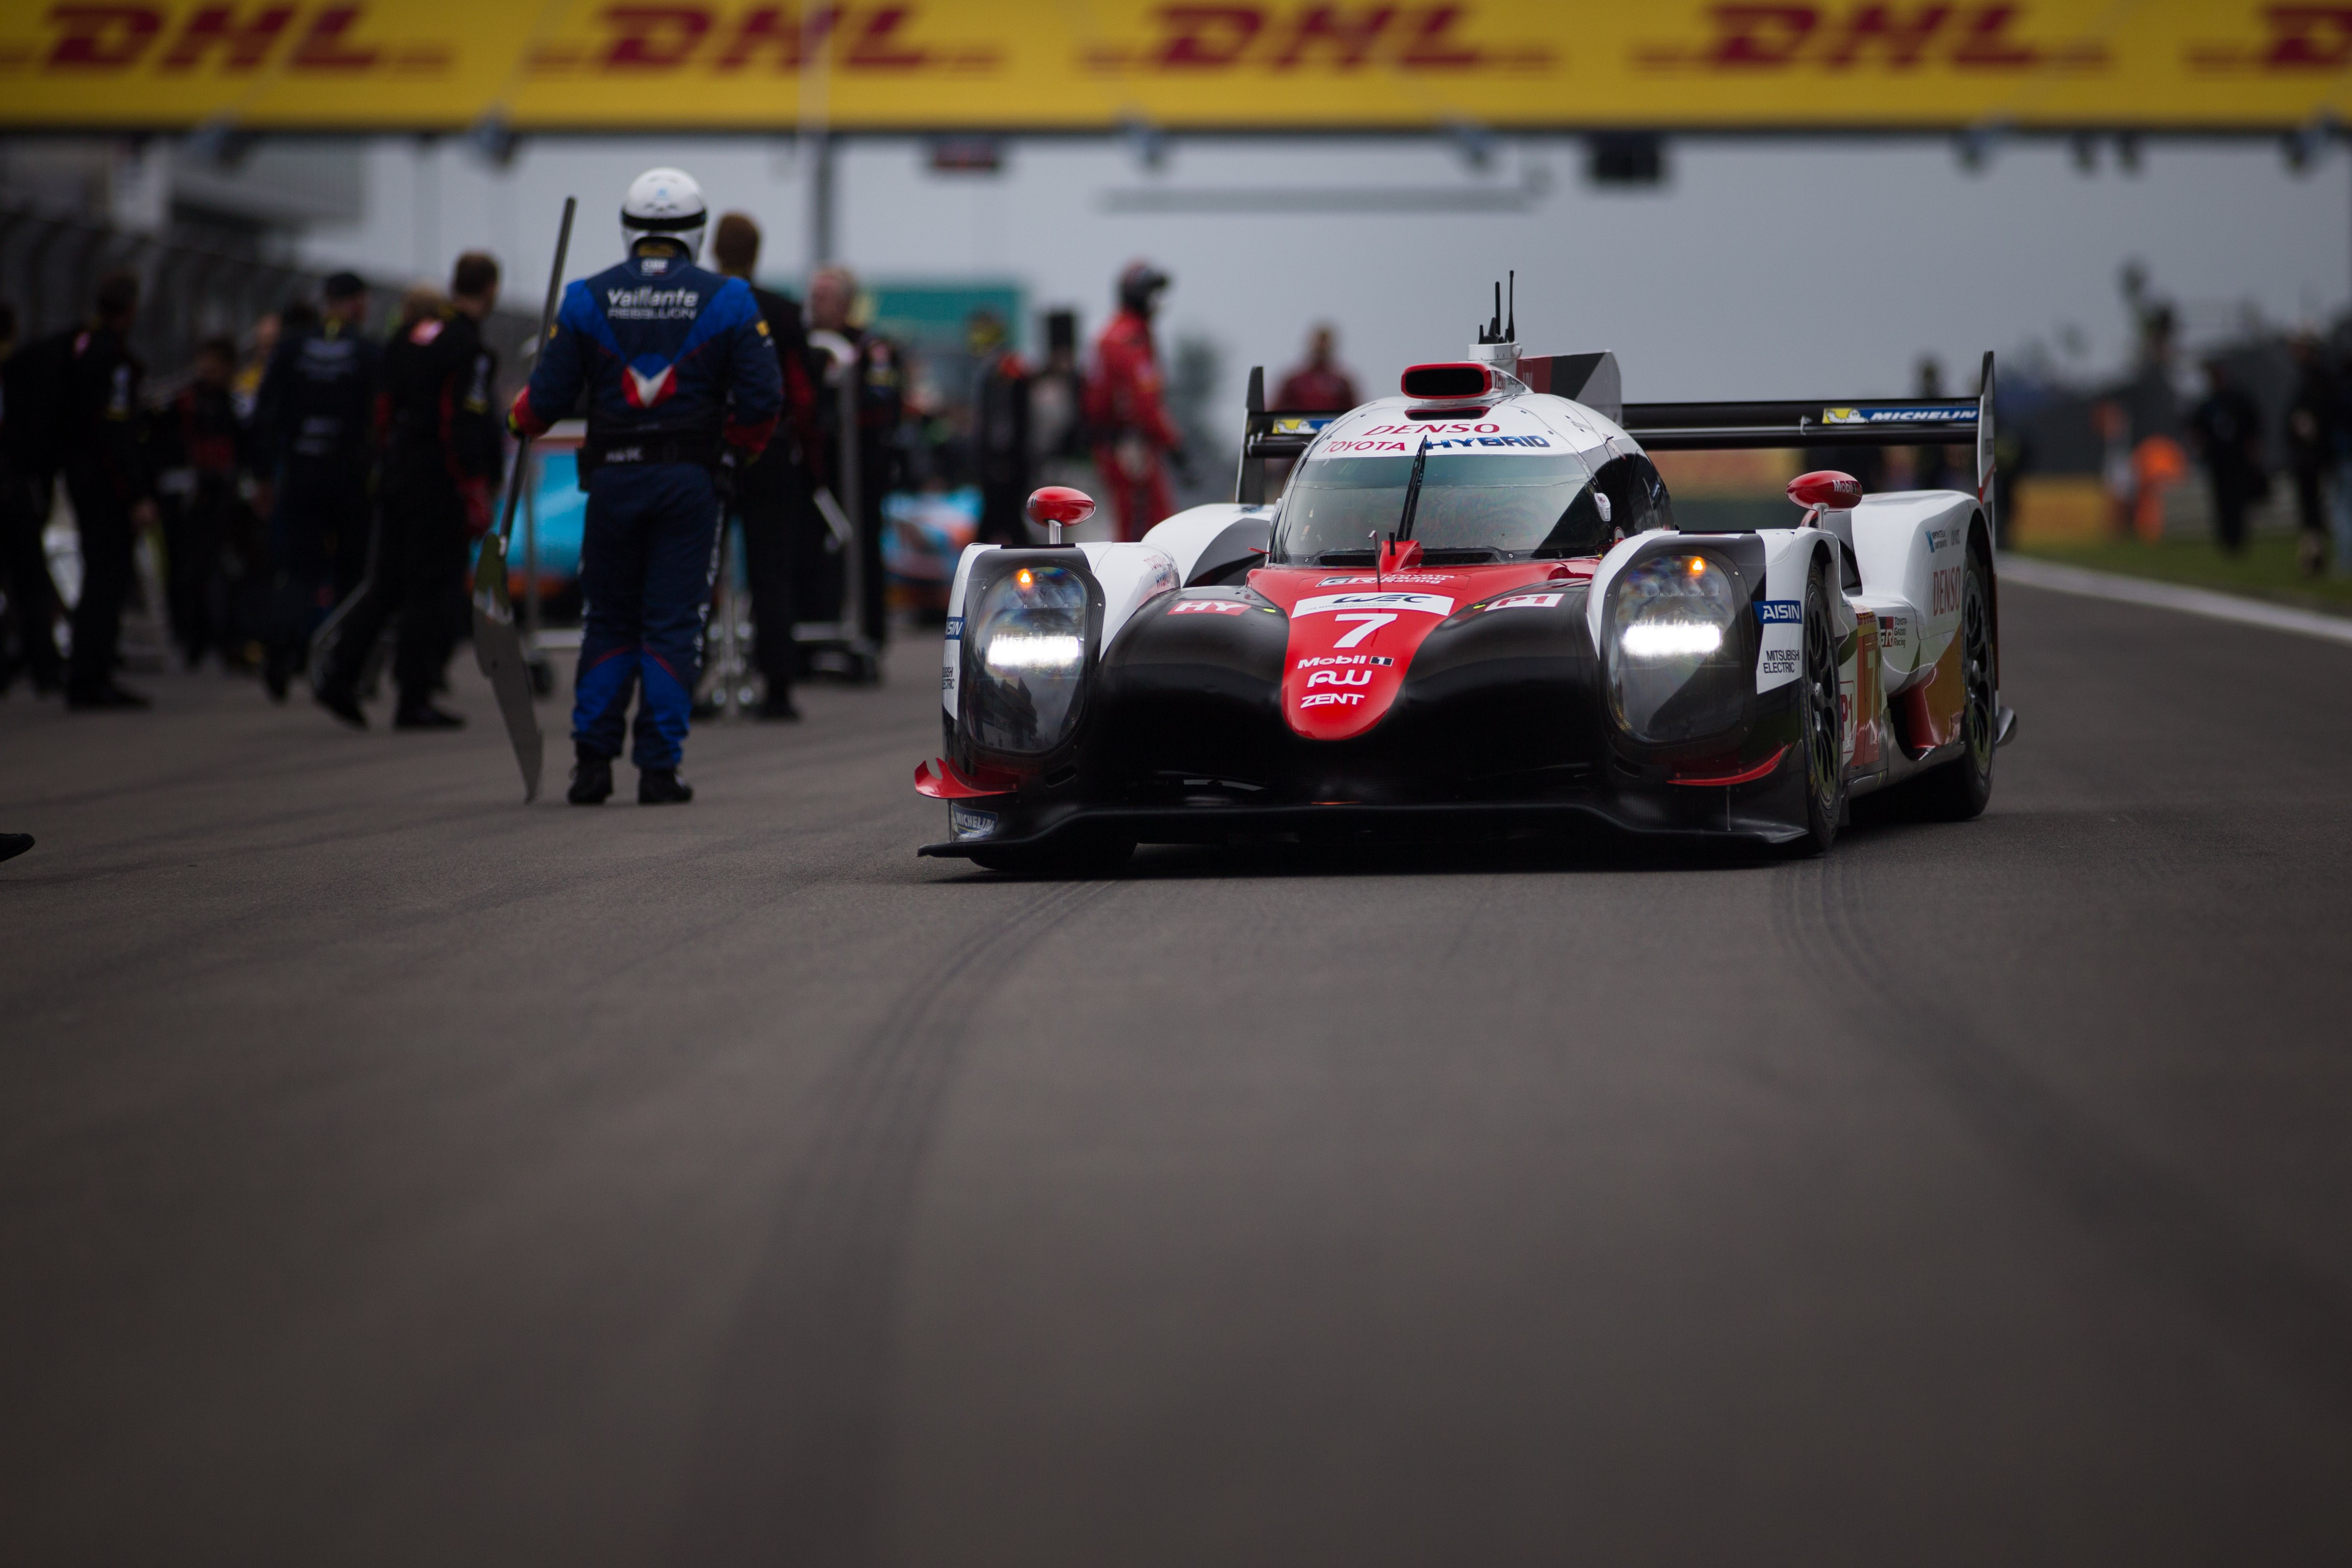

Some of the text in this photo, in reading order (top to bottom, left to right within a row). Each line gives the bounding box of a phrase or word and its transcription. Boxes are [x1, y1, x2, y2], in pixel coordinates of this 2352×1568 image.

[48, 4, 379, 71] DHL
[602, 4, 928, 71] DHL
[1154, 4, 1481, 71] DHL
[1707, 4, 2036, 71] DHL
[607, 286, 699, 307] Vaillante
[1870, 410, 1978, 421] MICHELIN
[1362, 423, 1500, 436] DENSO
[1322, 435, 1551, 453] TOYOTA HYBRID
[1832, 479, 1853, 493] Mobil
[1332, 594, 1432, 604] WEC
[1933, 566, 1960, 617] DENSO
[1174, 602, 1245, 612] HY
[1497, 596, 1550, 607] P1
[1763, 605, 1800, 619] AISIN
[1333, 613, 1398, 648] 7
[1894, 637, 1906, 648] Racing
[1297, 655, 1367, 669] Mobil
[1763, 662, 1795, 674] ELECTRIC
[1300, 693, 1365, 708] ZENT
[1840, 693, 1853, 742] P1
[956, 812, 995, 832] MICHELIN
